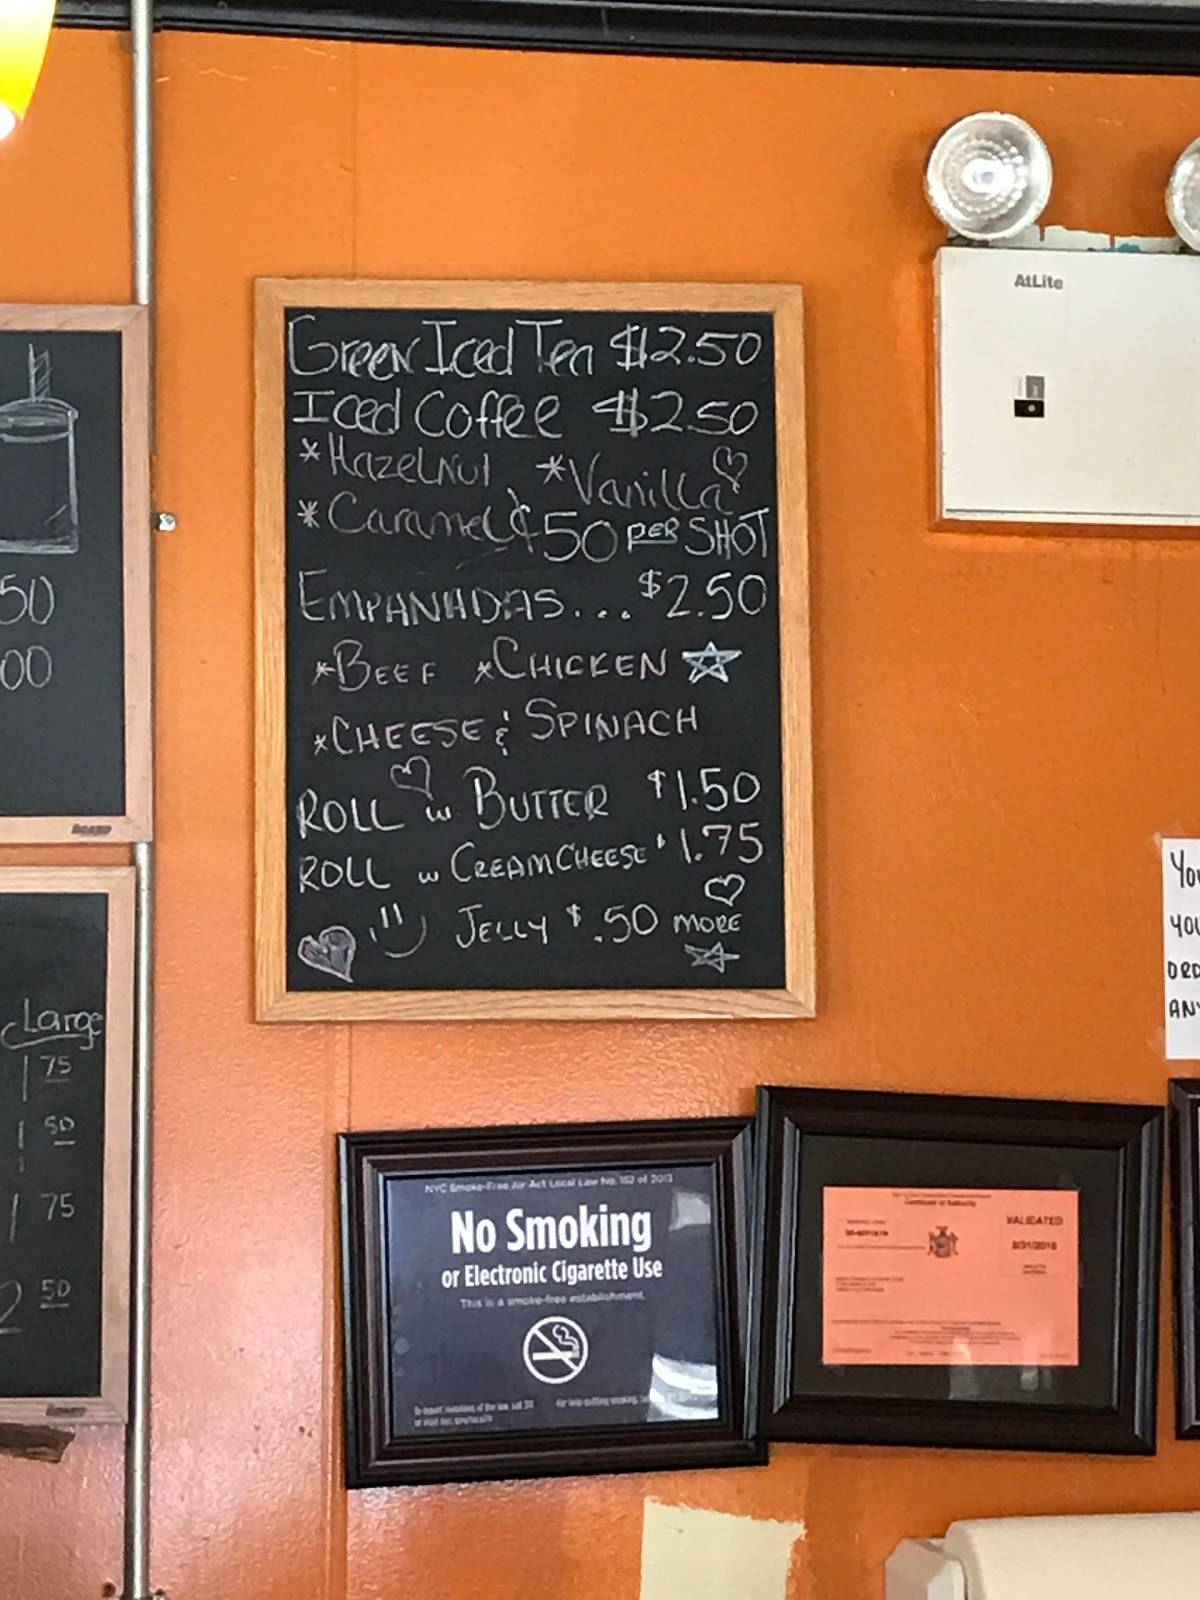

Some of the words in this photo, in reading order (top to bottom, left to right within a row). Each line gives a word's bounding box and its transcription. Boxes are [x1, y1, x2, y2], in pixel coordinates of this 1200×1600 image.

[1014, 273, 1063, 290] AtLite
[288, 314, 421, 381] Green
[421, 319, 514, 378] Iced
[609, 323, 763, 371] $2.50
[292, 387, 400, 435] Iced
[414, 389, 563, 439] Coffee
[569, 452, 735, 515] Vanilla
[328, 490, 515, 543] Caramel
[684, 507, 770, 560] SHOT
[638, 569, 768, 621] $2.50
[492, 636, 668, 681] CHICKEN
[331, 714, 485, 755] CHEESE
[525, 698, 698, 741] SPINACH
[296, 788, 405, 840] ROLL
[462, 766, 609, 830] BUTTER
[299, 856, 392, 894] ROLL
[455, 904, 549, 949] JELLY
[23, 997, 104, 1050] Large
[450, 1210, 497, 1254] No
[506, 1203, 652, 1253] Smoking
[441, 1269, 460, 1289] or
[464, 1260, 548, 1288] Electronic
[551, 1256, 629, 1286] Cigarette
[632, 1255, 664, 1279] Use
